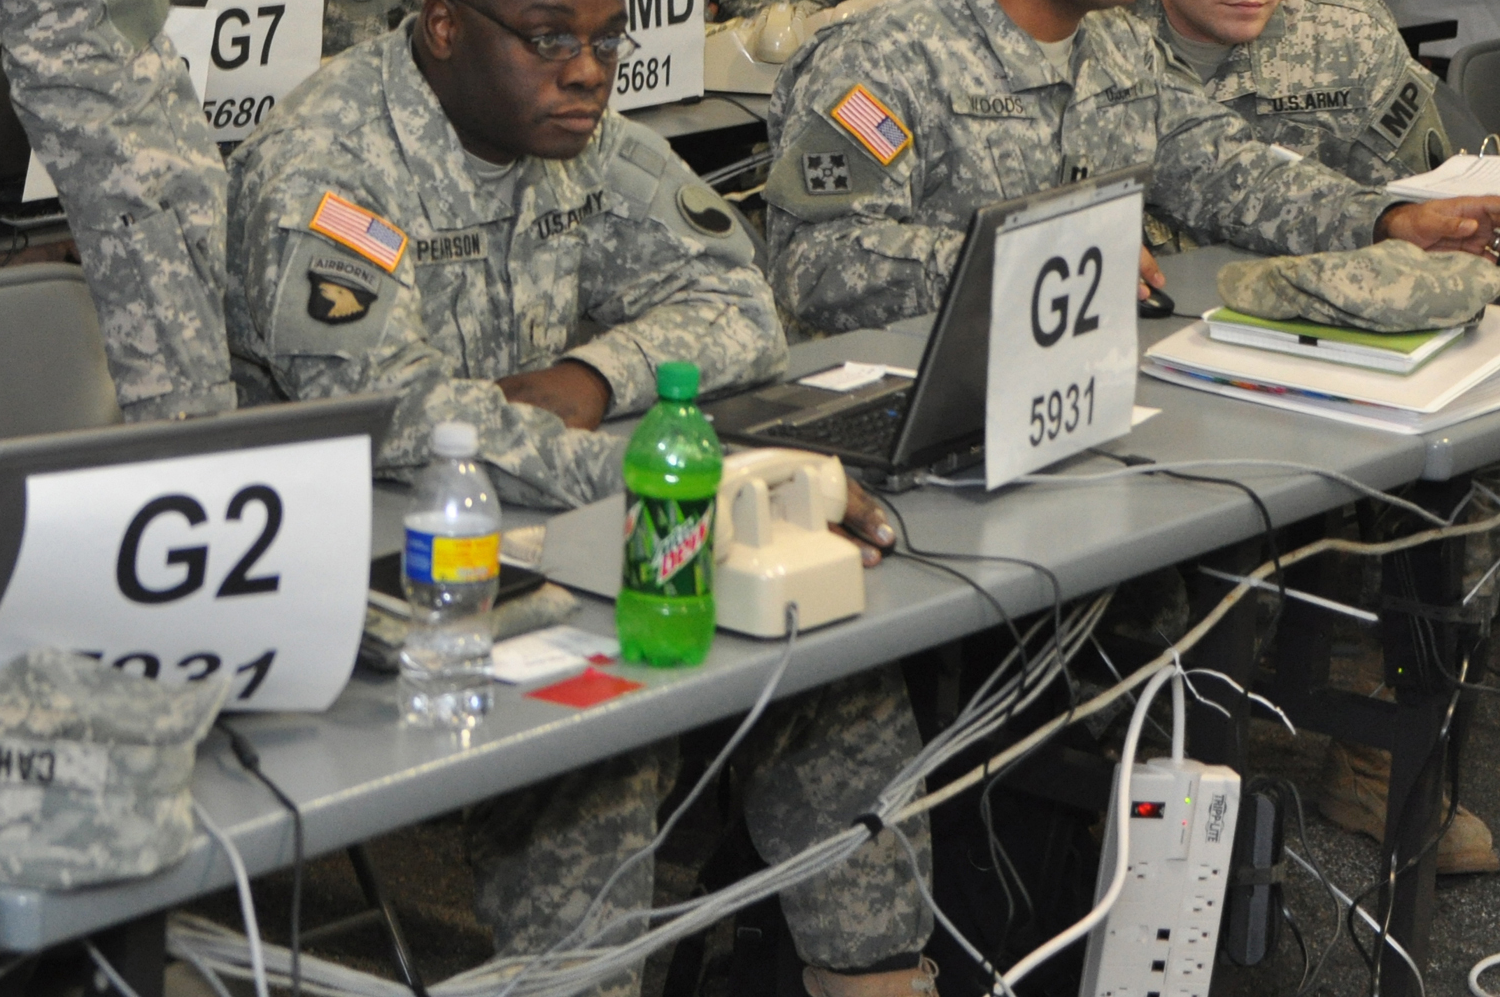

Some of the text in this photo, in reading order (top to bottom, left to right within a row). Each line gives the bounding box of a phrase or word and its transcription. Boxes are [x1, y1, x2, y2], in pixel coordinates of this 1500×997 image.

[209, 4, 286, 72] G7
[616, 53, 672, 96] 5681
[968, 94, 1025, 115] WOODS
[1380, 81, 1420, 139] MP
[315, 257, 377, 286] AIRBORNE
[416, 233, 482, 262] PEARSON
[1030, 245, 1104, 349] G2
[1029, 374, 1096, 448] 5931
[115, 483, 285, 607] G2
[76, 649, 277, 701] 31
